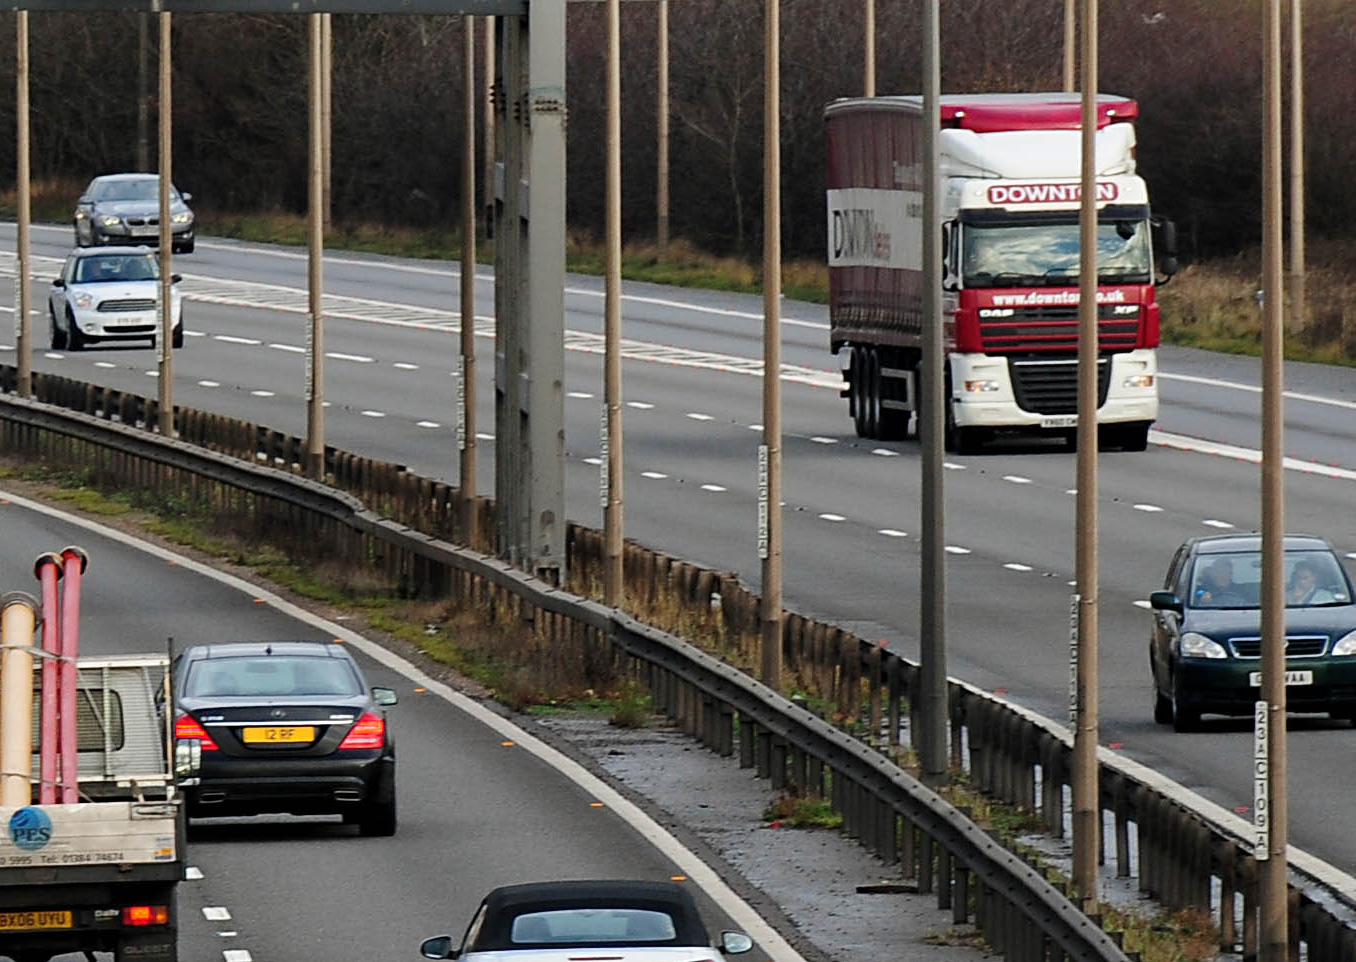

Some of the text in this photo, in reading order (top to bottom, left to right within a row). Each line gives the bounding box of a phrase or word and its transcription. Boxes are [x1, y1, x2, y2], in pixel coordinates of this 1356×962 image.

[990, 184, 1114, 202] DOWNTN
[992, 290, 1124, 306] www.downtoo.uk
[1256, 761, 1267, 775] C
[0, 911, 66, 929] BX06 UYU
